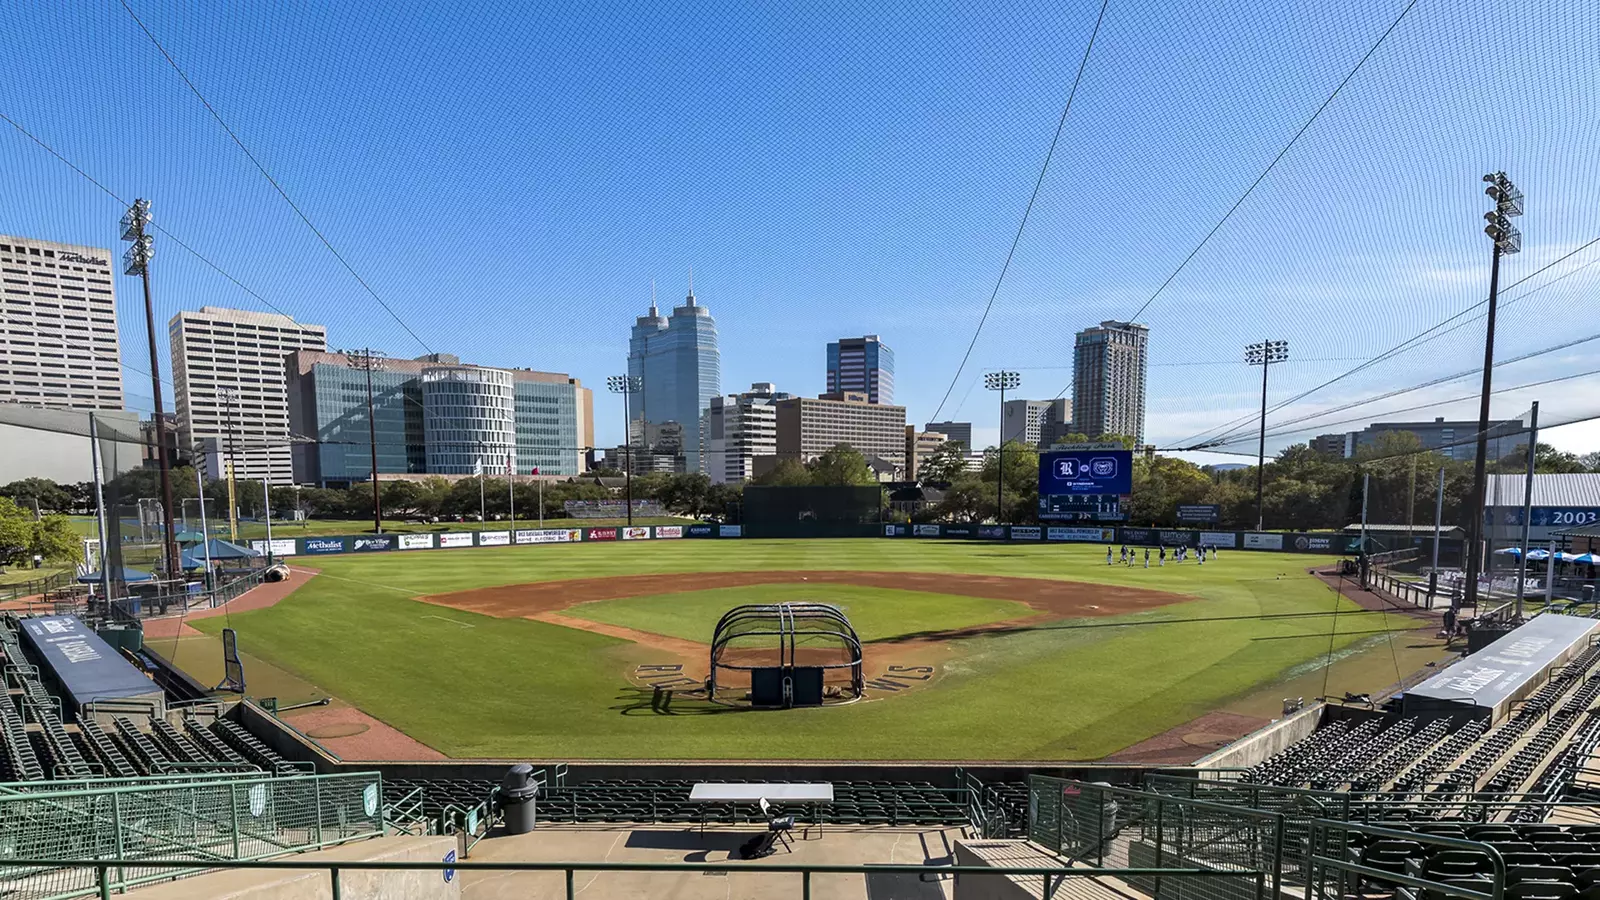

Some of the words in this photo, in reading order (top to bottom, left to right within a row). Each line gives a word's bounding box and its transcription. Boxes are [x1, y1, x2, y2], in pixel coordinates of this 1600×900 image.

[59, 254, 108, 267] Methodist
[1552, 511, 1597, 524] 2003
[307, 540, 343, 549] Methodist
